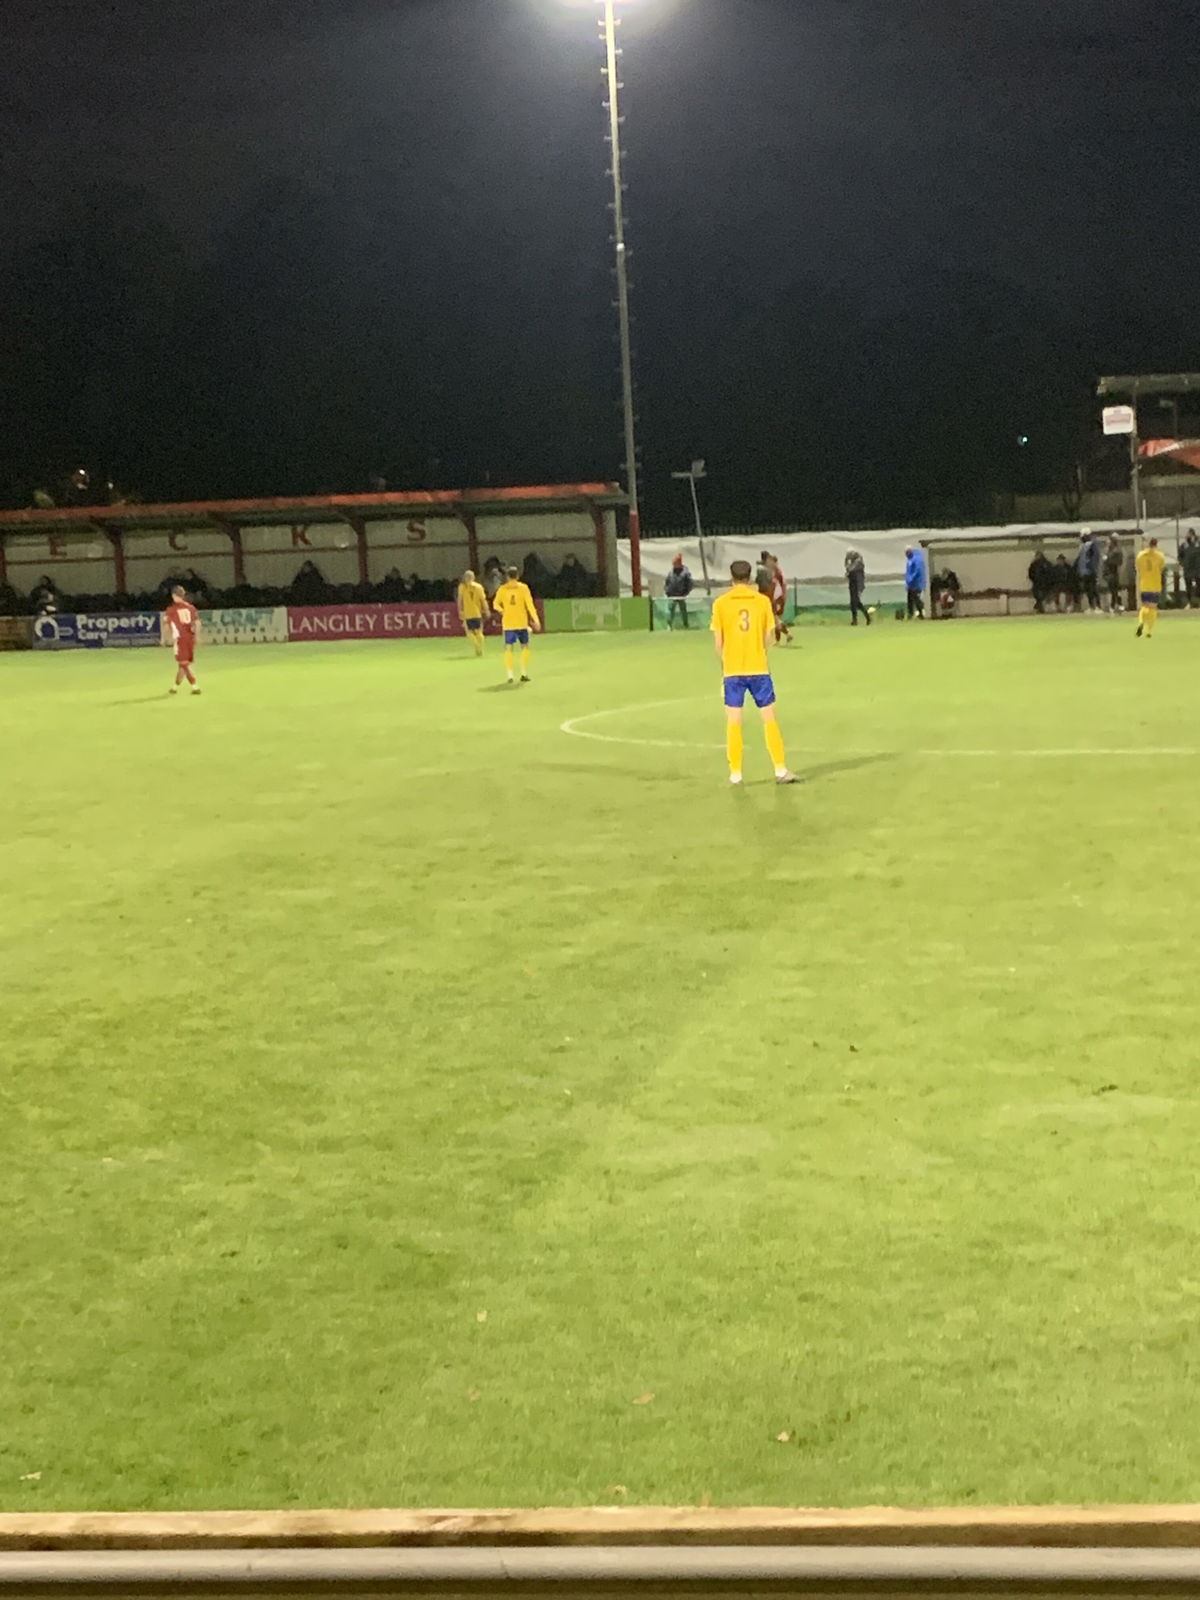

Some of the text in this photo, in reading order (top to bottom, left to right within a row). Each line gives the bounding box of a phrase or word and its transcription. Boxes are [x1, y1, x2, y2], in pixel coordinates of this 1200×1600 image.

[76, 613, 155, 632] Property
[289, 614, 377, 633] LANGLEY
[383, 611, 451, 630] ESTATE
[738, 608, 750, 632] 3
